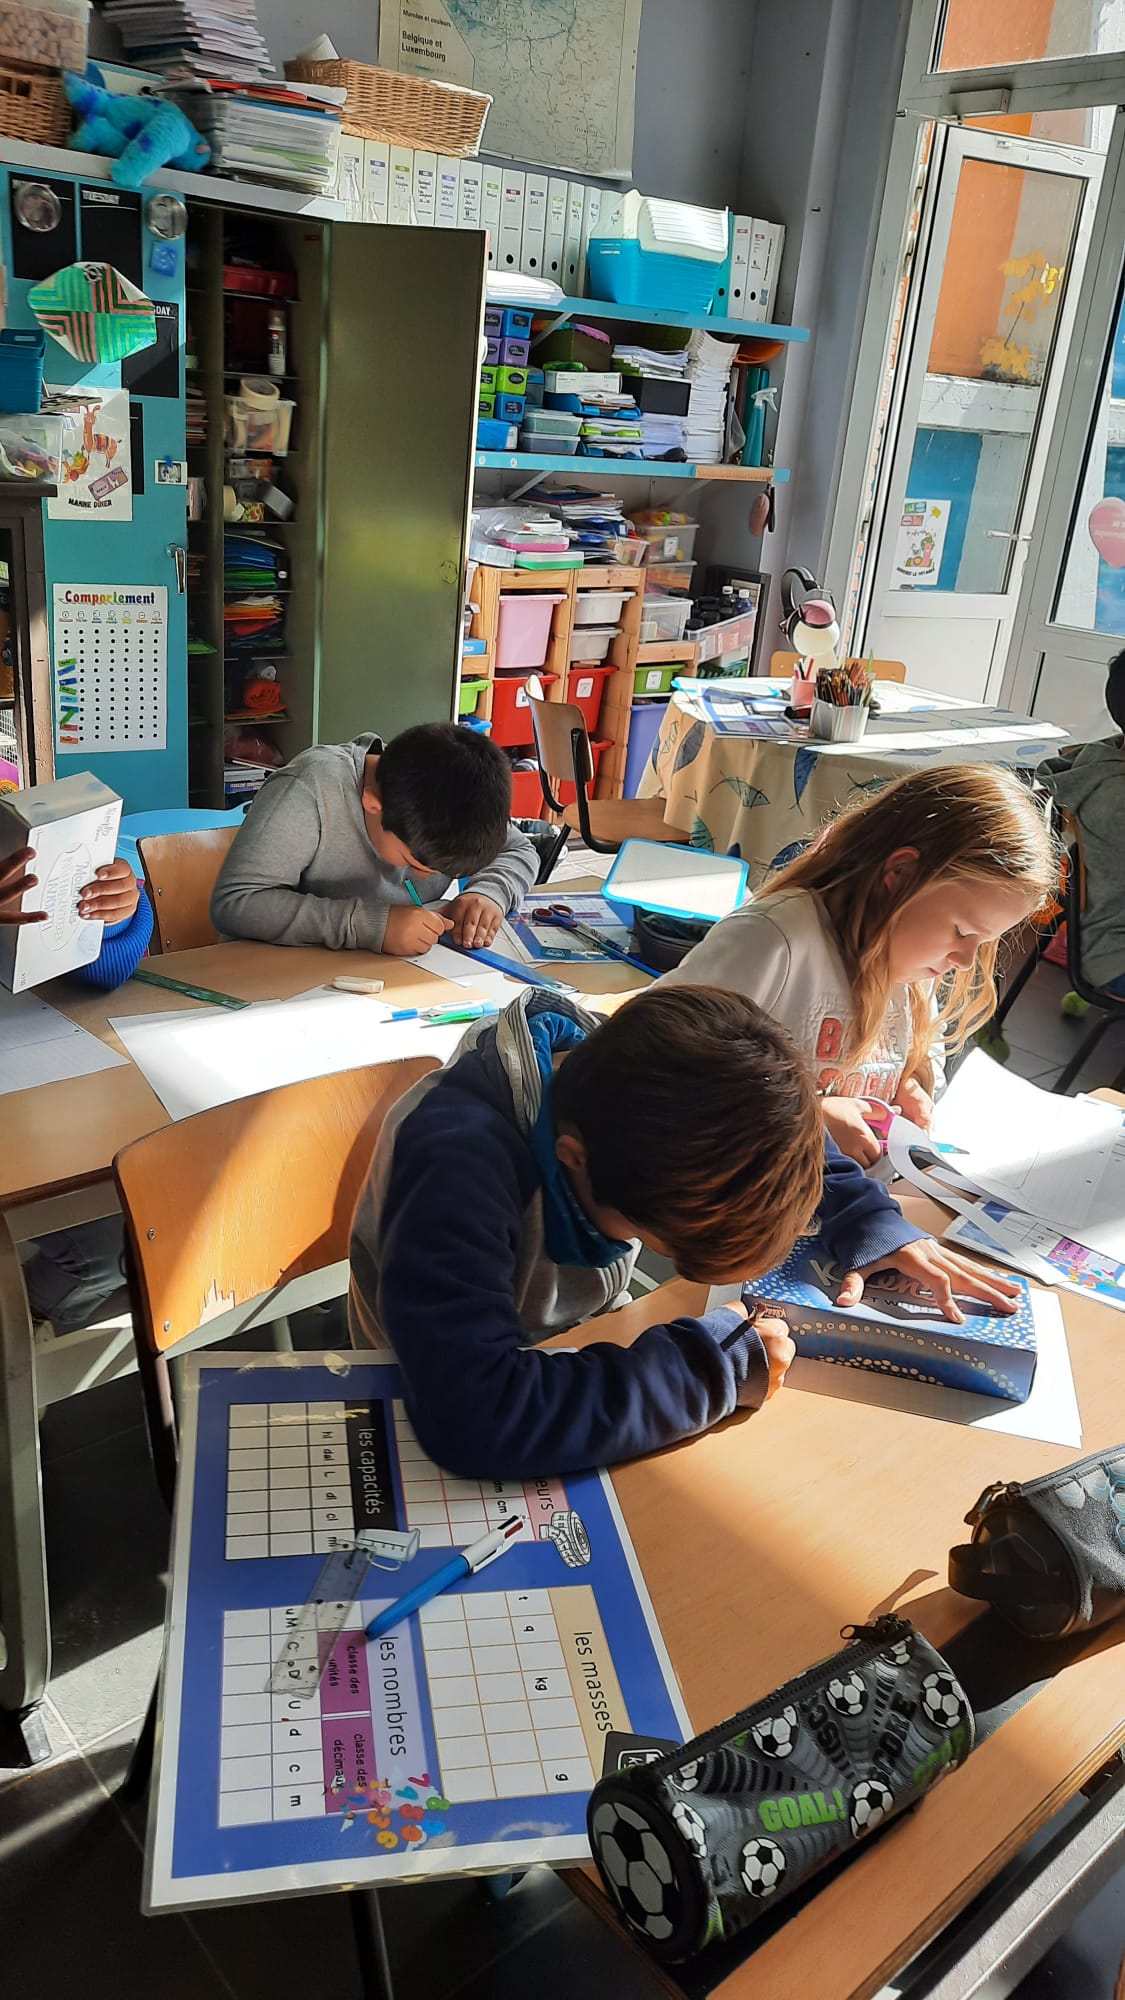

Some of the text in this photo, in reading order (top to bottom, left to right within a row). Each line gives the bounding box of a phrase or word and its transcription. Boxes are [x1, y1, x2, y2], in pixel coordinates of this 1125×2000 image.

[402, 30, 442, 48] Belgique et
[401, 42, 446, 63] Luxembourg
[65, 590, 155, 606] Comportement
[323, 1449, 335, 1462] dal
[356, 1428, 384, 1515] les capacités
[325, 1492, 337, 1501] dl
[535, 1480, 554, 1511] eurs
[497, 1500, 507, 1514] cm
[328, 1659, 342, 1687] unités
[347, 1646, 360, 1694] classe des
[535, 1676, 548, 1691] kg
[573, 1631, 614, 1732] les masses
[288, 1700, 302, 1710] U
[379, 1636, 408, 1756] les nombres
[289, 1728, 302, 1736] d
[289, 1764, 301, 1773] c
[333, 1739, 345, 1789] décimaux
[353, 1733, 368, 1788] classe des
[555, 1773, 568, 1781] g
[290, 1795, 301, 1807] m
[759, 1789, 847, 1833] GOAL!
